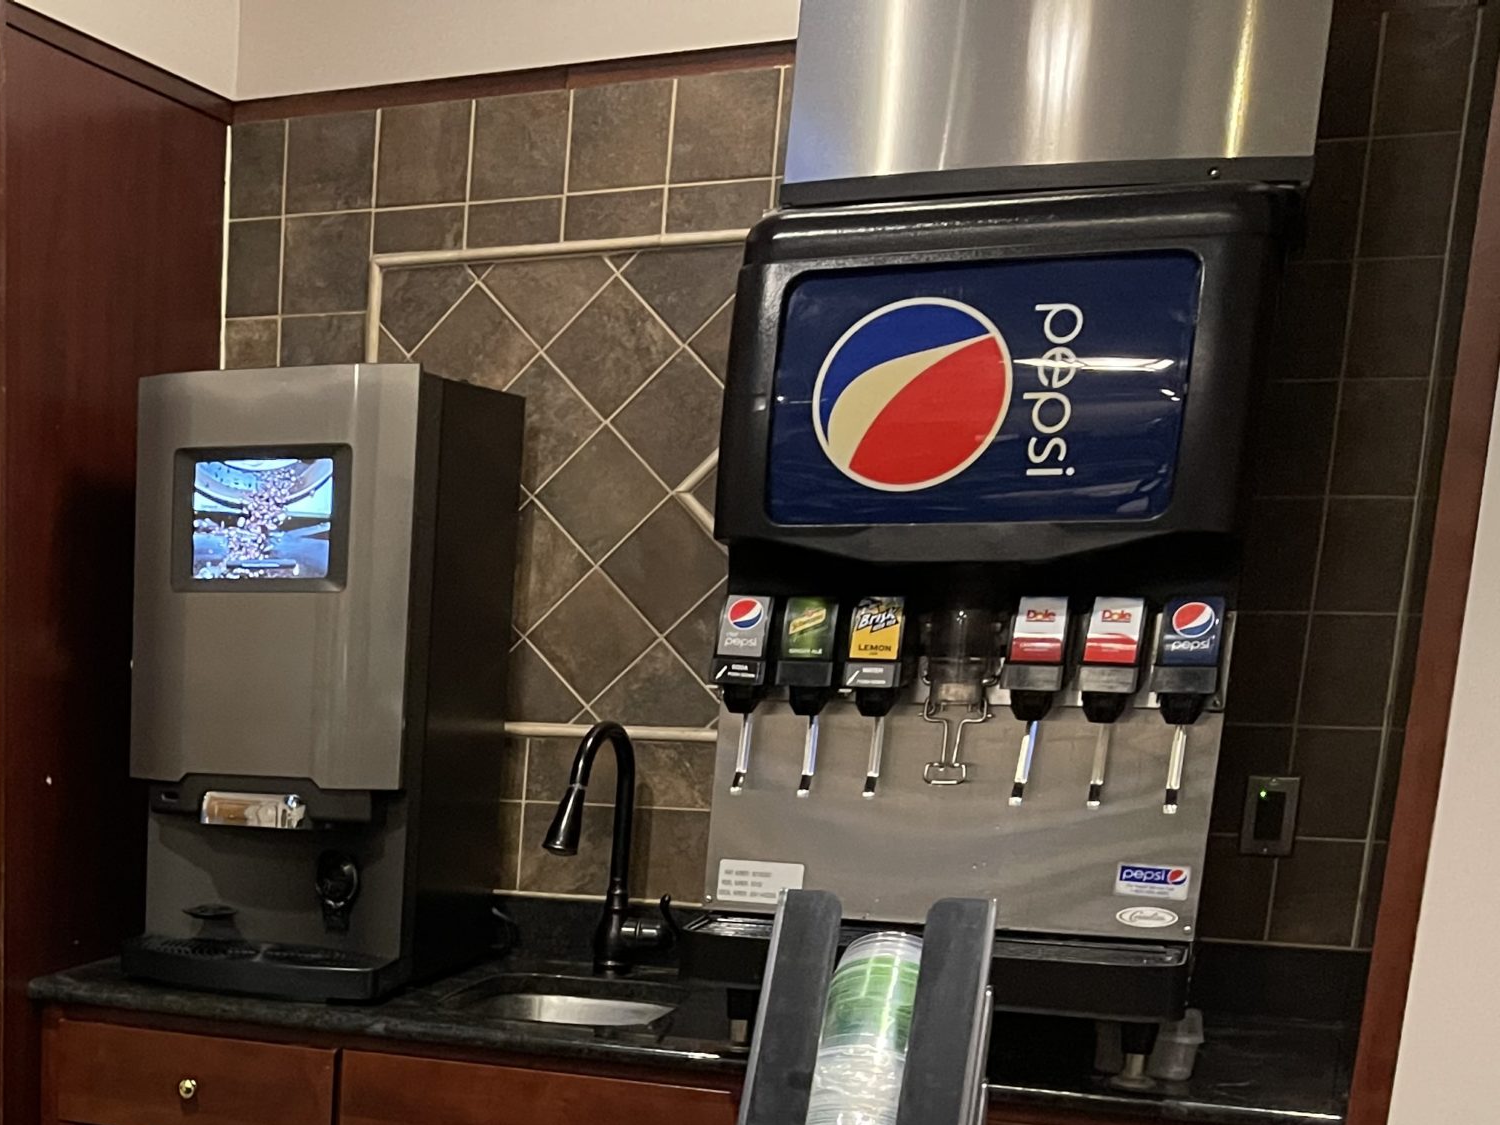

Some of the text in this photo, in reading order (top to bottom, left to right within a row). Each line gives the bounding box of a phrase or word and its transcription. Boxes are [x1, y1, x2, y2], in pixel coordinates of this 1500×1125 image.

[1022, 302, 1085, 478] pepsi
[1025, 608, 1056, 622] Dole
[1101, 608, 1132, 622] Dole
[857, 643, 892, 652] LEMON
[1170, 637, 1211, 651] pepsi
[1122, 868, 1166, 882] pepsi
